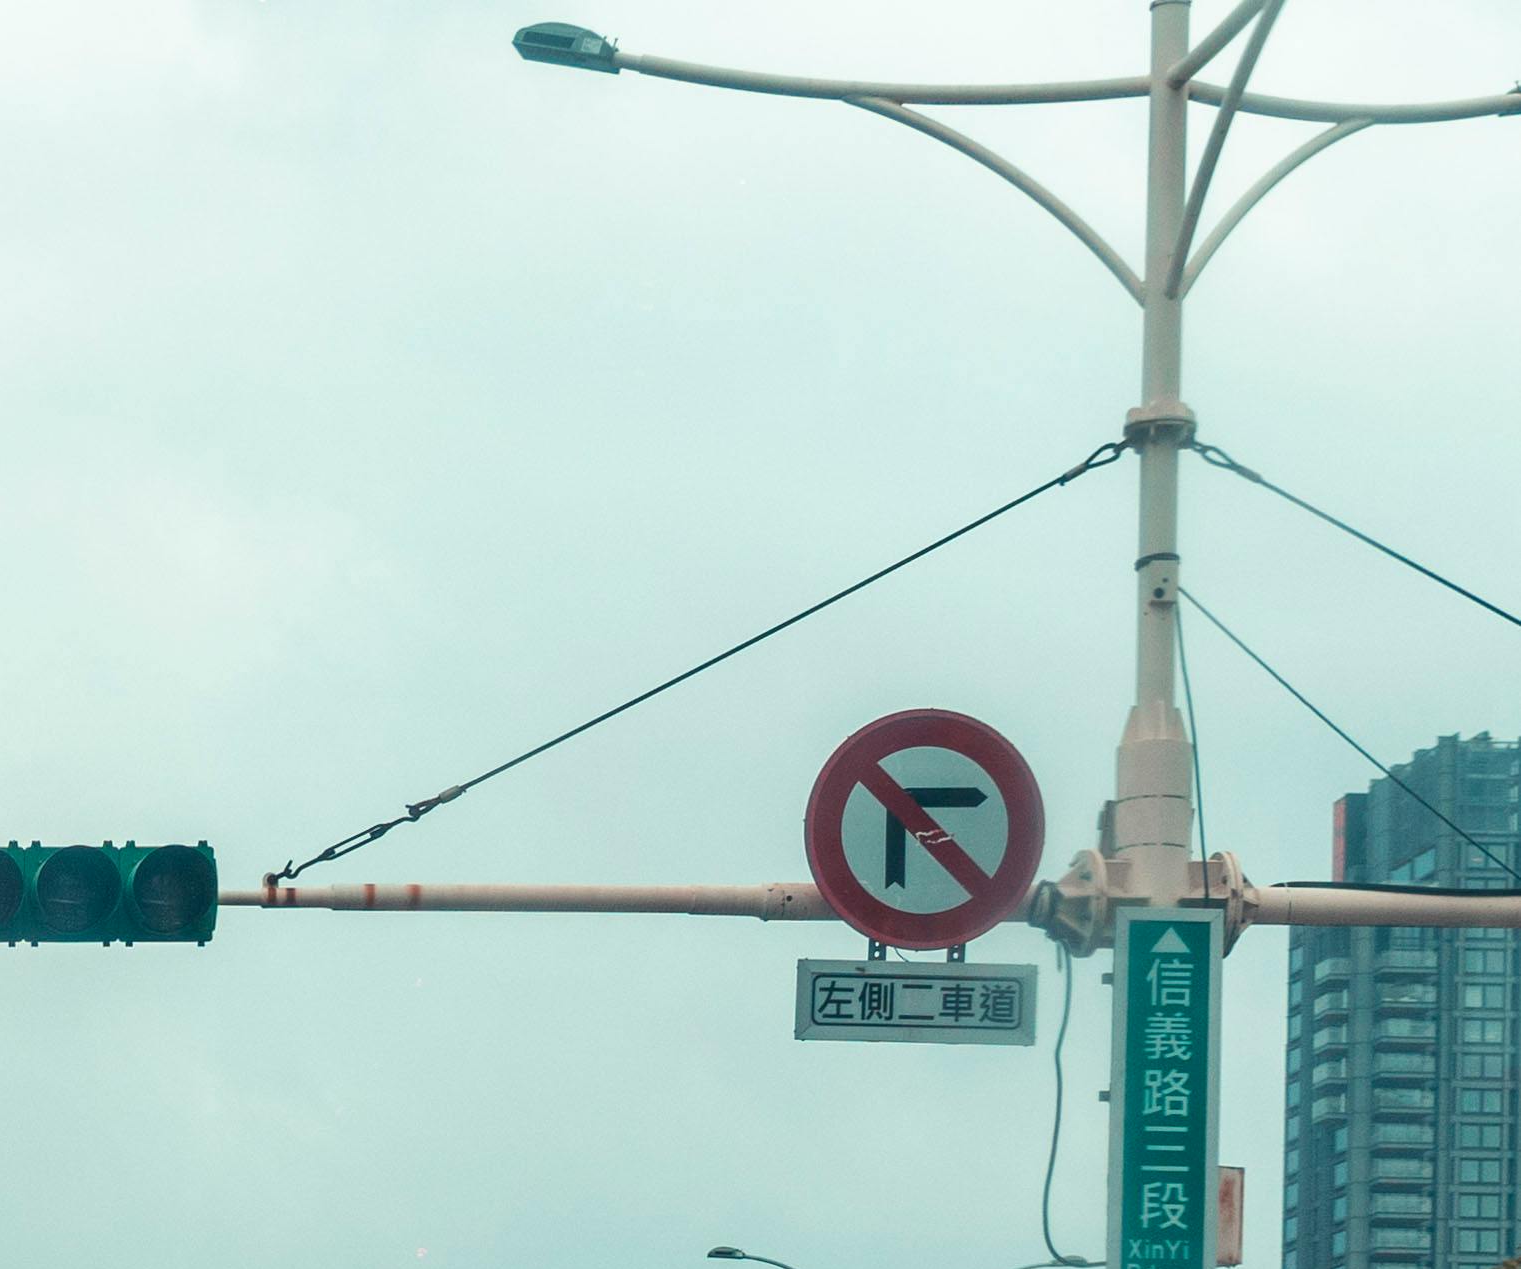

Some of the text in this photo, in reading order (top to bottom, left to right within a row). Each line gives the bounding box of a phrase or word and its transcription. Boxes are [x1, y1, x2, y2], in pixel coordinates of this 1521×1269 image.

[818, 979, 1017, 1025] 左側二車道
[1141, 958, 1194, 1231] 信義路三段
[1128, 1239, 1190, 1260] XinYi
